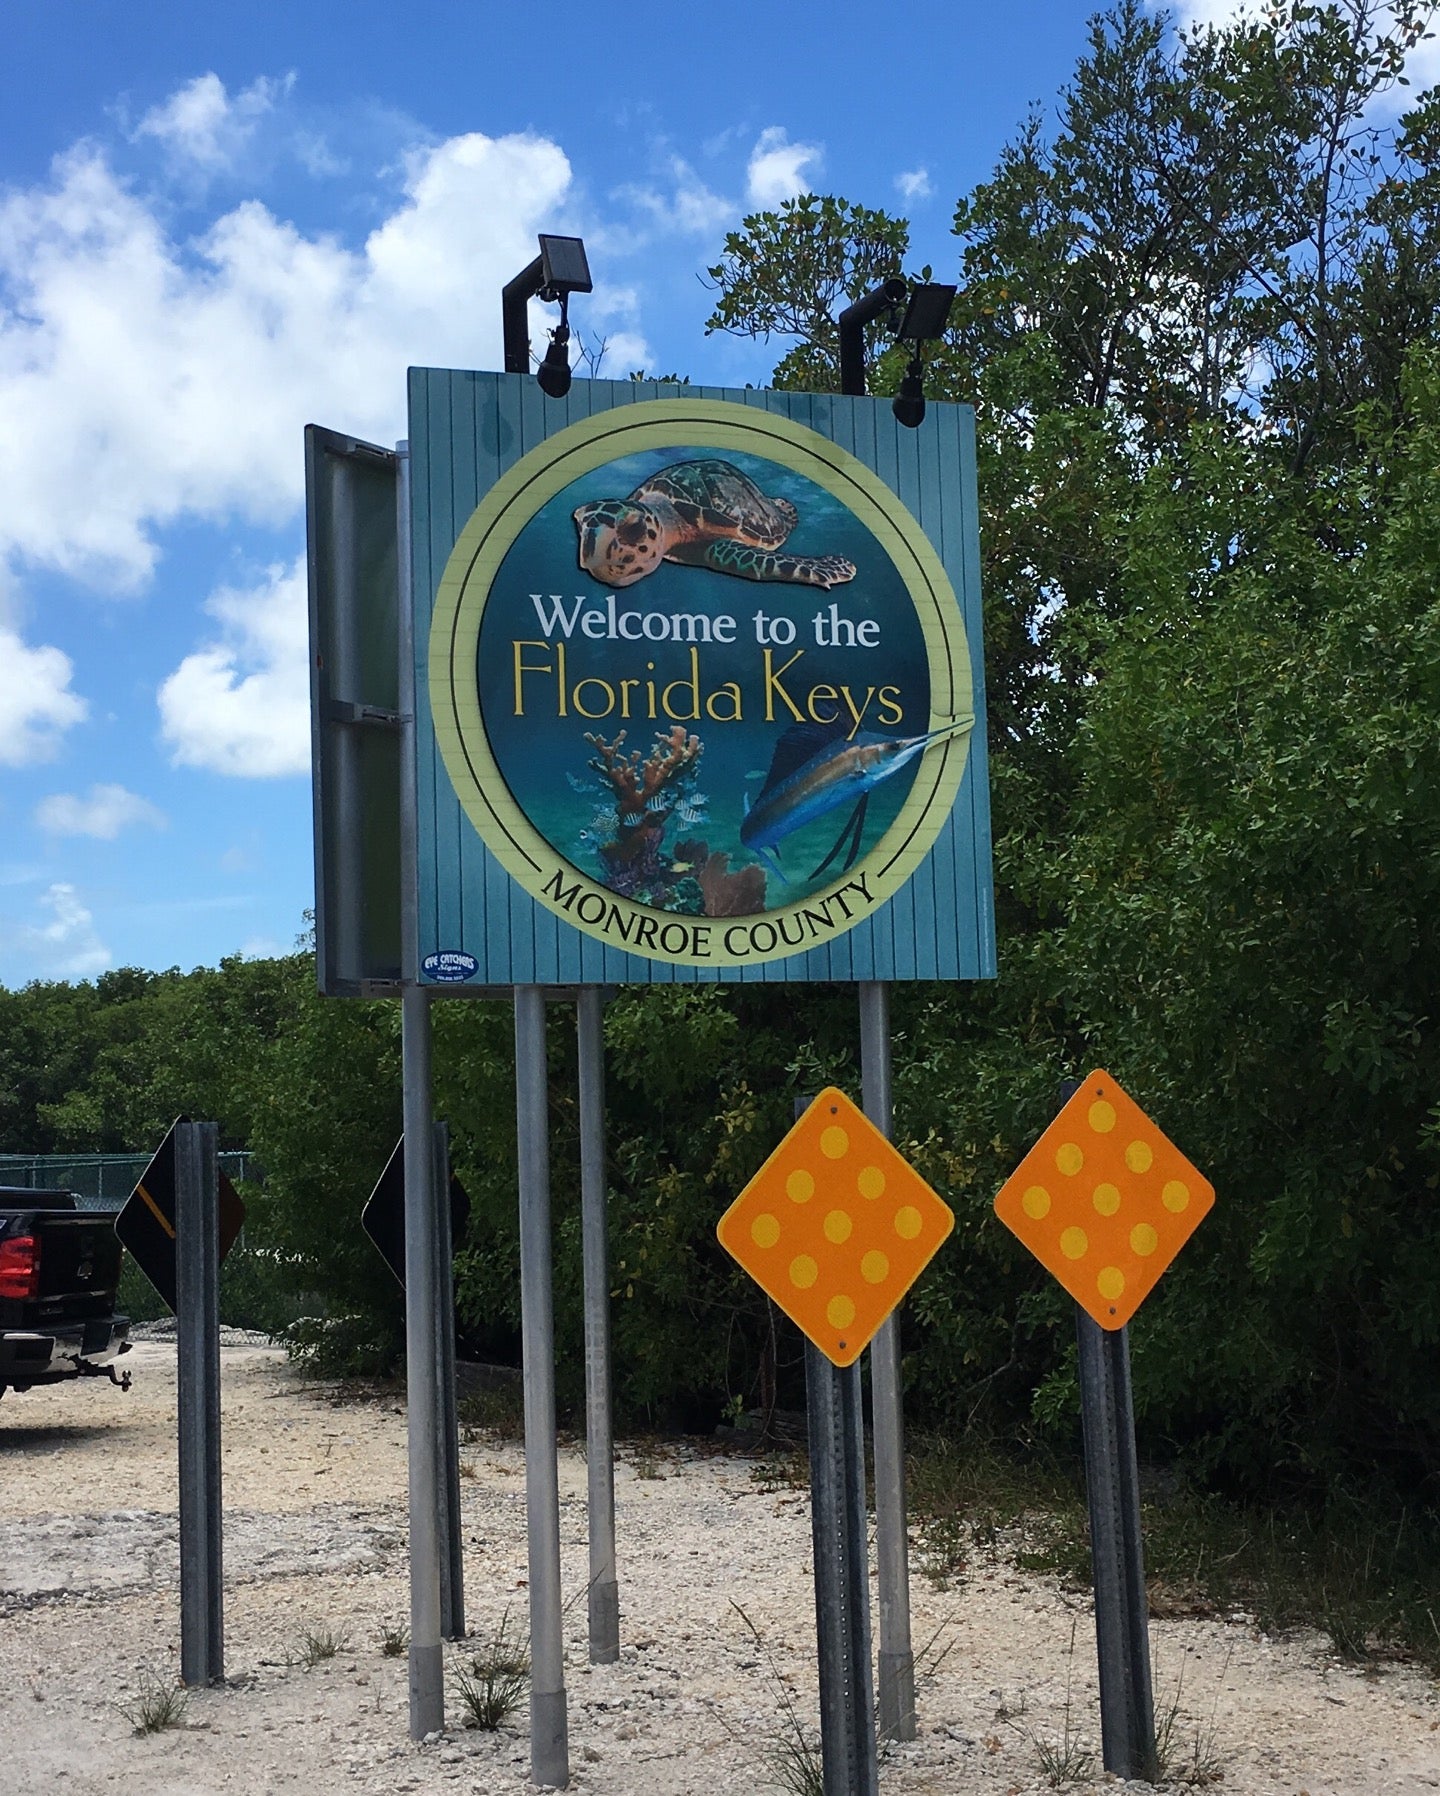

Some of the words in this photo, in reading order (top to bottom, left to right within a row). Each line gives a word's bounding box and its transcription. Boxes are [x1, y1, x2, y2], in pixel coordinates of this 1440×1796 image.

[529, 594, 737, 643] Welcome
[752, 609, 797, 645] to
[814, 604, 881, 647] the
[512, 640, 743, 722] Florida
[763, 648, 904, 742] Keys
[540, 868, 712, 958] MONROE
[723, 871, 875, 957] COUNTY
